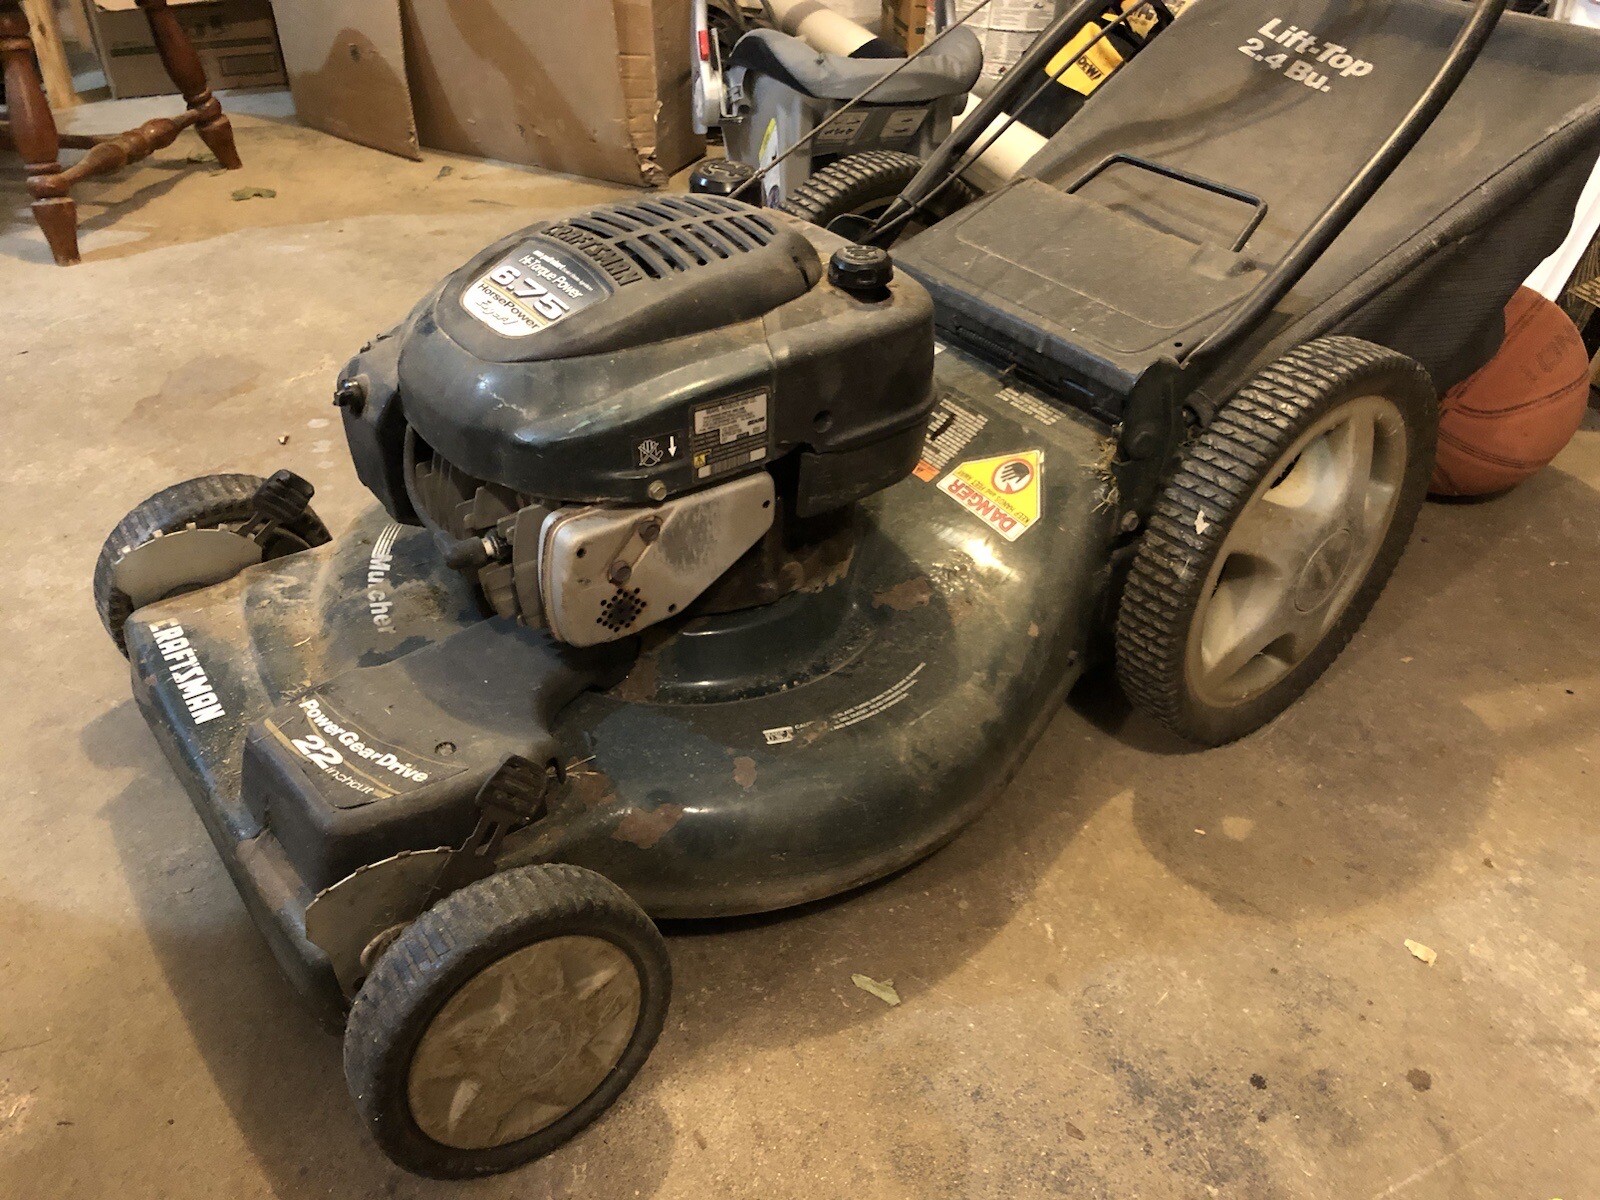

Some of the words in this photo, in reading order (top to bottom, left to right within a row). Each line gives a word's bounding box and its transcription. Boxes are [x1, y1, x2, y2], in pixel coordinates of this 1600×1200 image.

[1237, 37, 1289, 70] 2.4
[1283, 59, 1331, 93] Bu.
[1257, 17, 1374, 77] Lift-Top
[540, 223, 643, 287] CRAFTSMAN
[477, 283, 540, 330] HorsePower
[489, 264, 570, 321] 6.75
[551, 275, 584, 299] Power
[947, 478, 1018, 533] DANGER
[994, 495, 1016, 514] HANDS
[367, 554, 397, 634] Mucher
[148, 618, 226, 725] CRAFTSMAN
[291, 734, 344, 770] 22
[299, 699, 429, 782] PowerGearDrive
